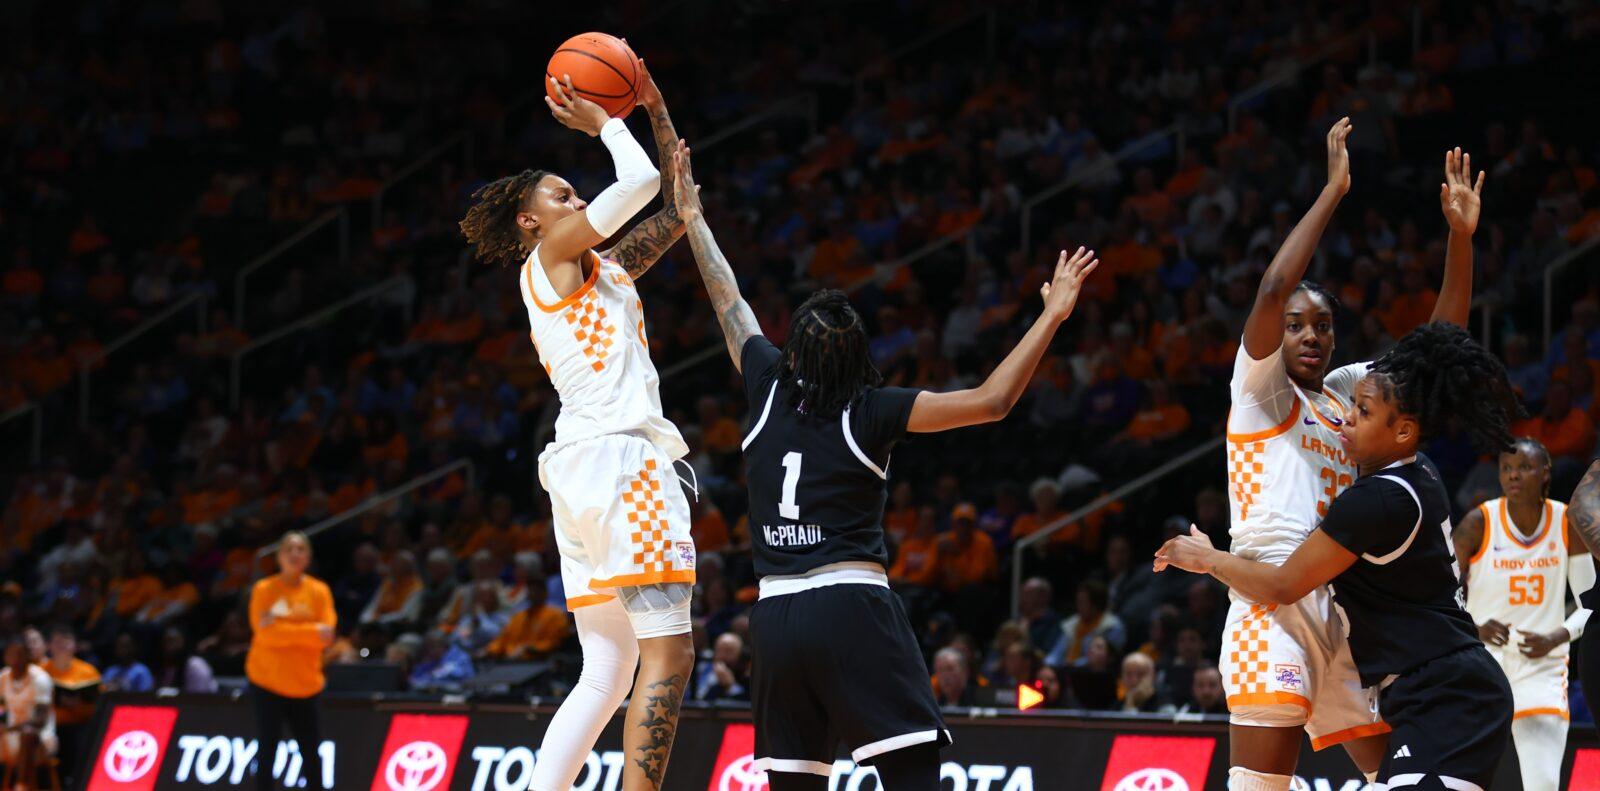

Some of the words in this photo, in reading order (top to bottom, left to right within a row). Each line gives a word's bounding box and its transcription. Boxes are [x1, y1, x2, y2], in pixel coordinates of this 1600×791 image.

[778, 451, 802, 520] 1
[1493, 558, 1525, 569] LADY
[1529, 556, 1559, 568] VOLS
[1508, 574, 1545, 605] 53
